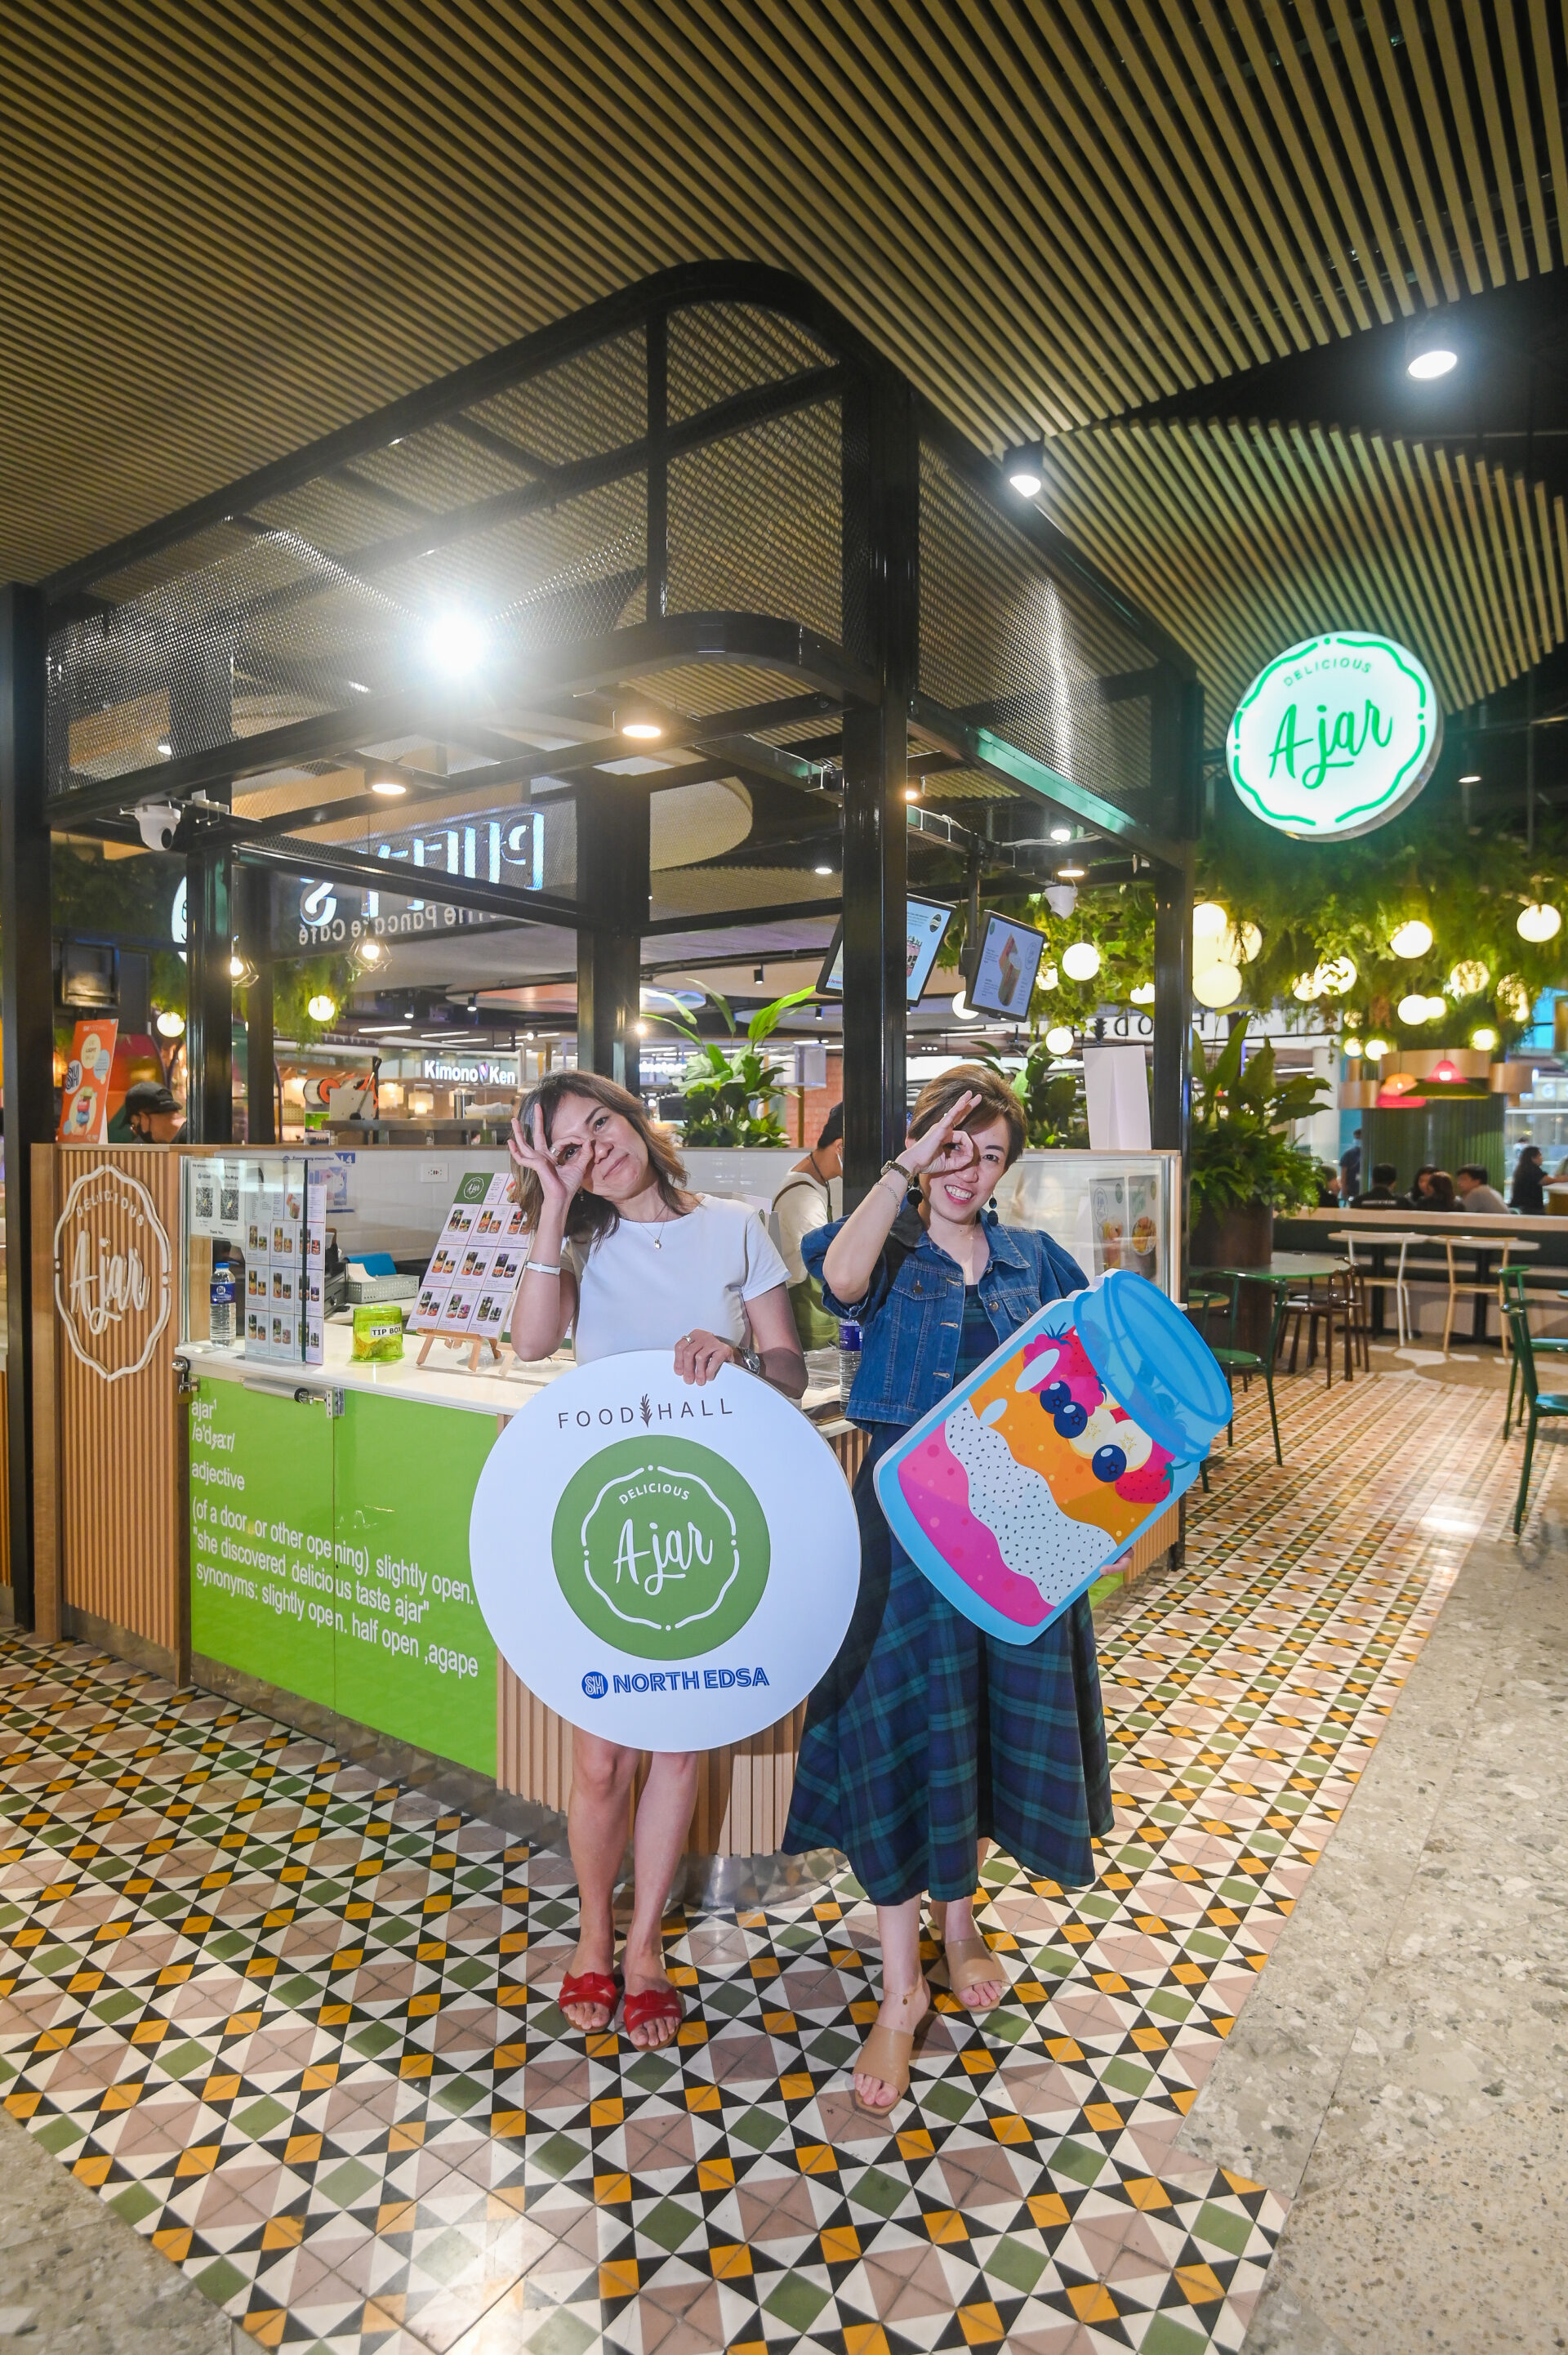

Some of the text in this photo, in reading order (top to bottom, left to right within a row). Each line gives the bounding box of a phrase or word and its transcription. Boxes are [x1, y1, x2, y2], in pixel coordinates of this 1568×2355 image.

[1284, 657, 1372, 687] DELICIOUS
[1269, 699, 1392, 789] Ajar
[425, 1060, 516, 1084] Kimono Ken
[75, 1189, 145, 1228] DELICIOUS
[69, 1229, 152, 1336] Ajar
[559, 1398, 733, 1430] FOOD HALL
[191, 1460, 245, 1491] adjective
[618, 1483, 691, 1505] DELICIOUS
[192, 1496, 474, 1605] (of a door or other opening) slightly open.
[612, 1519, 713, 1596] Ajar
[193, 1526, 430, 1626] "she discovered delicious taste ajar"
[196, 1563, 479, 1679] synonyms: slightly open. half open ,agape
[612, 1671, 700, 1694] NORTH
[703, 1667, 770, 1689] EDSA
